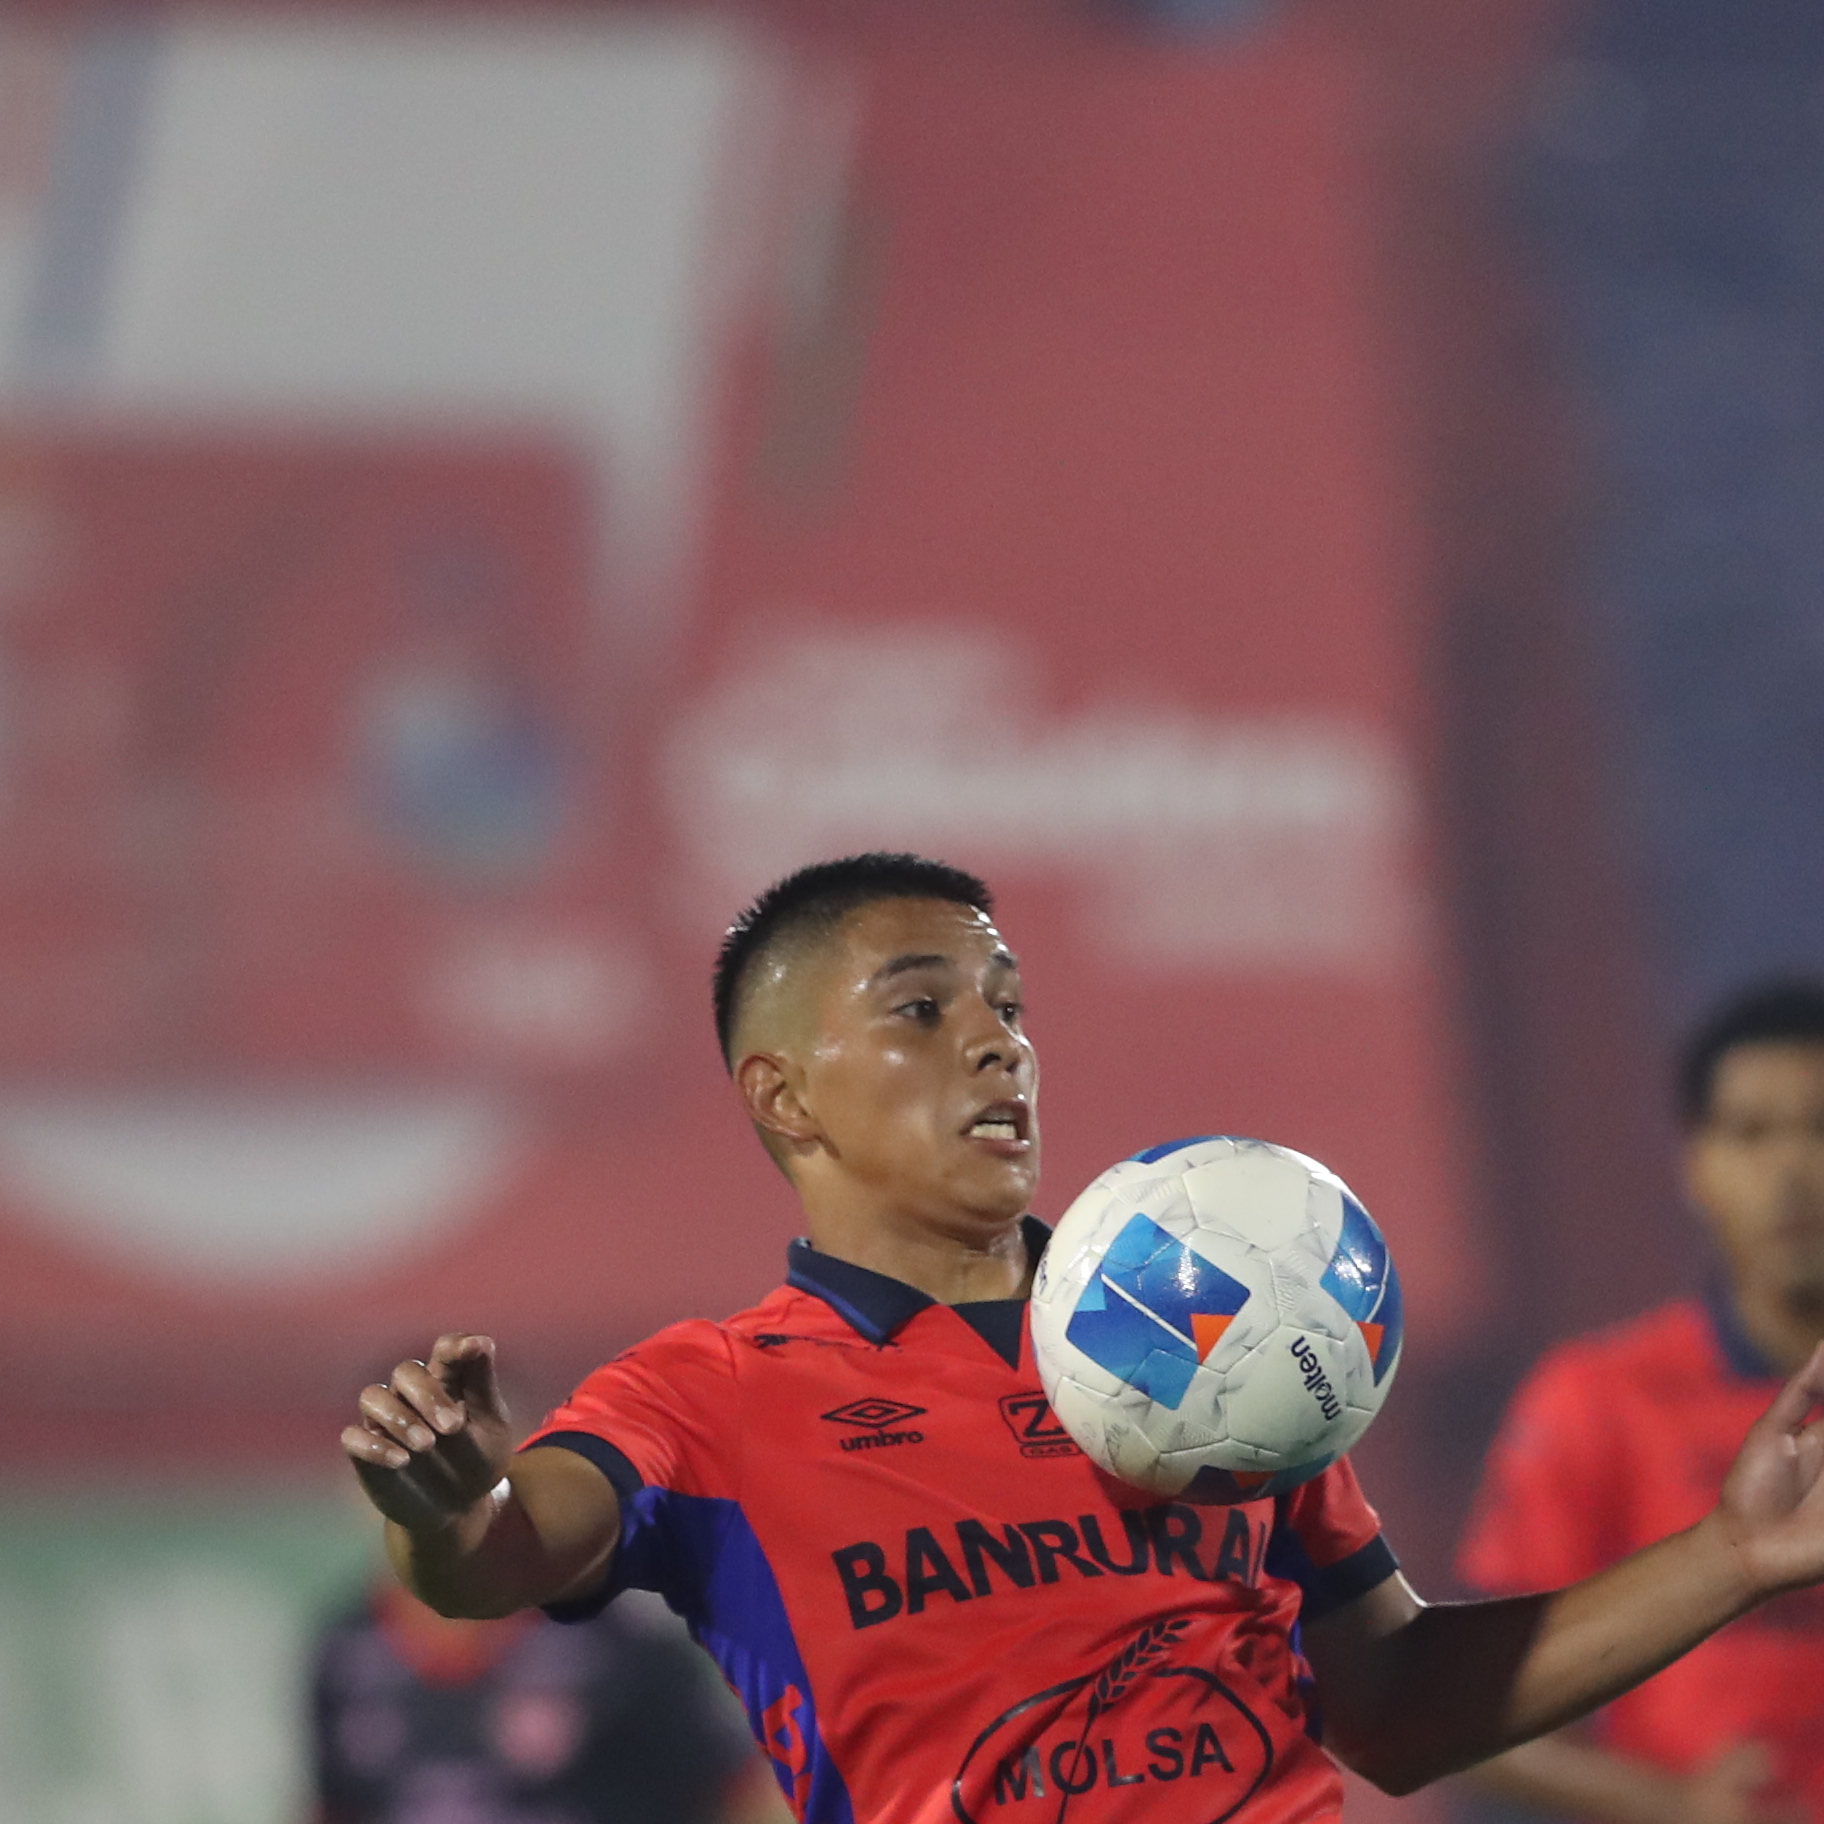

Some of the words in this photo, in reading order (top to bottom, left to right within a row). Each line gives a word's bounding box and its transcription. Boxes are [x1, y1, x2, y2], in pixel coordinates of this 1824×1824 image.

[1290, 1335, 1342, 1422] molten
[839, 1428, 925, 1452] umbro
[994, 1722, 1236, 1806] MOLSA
